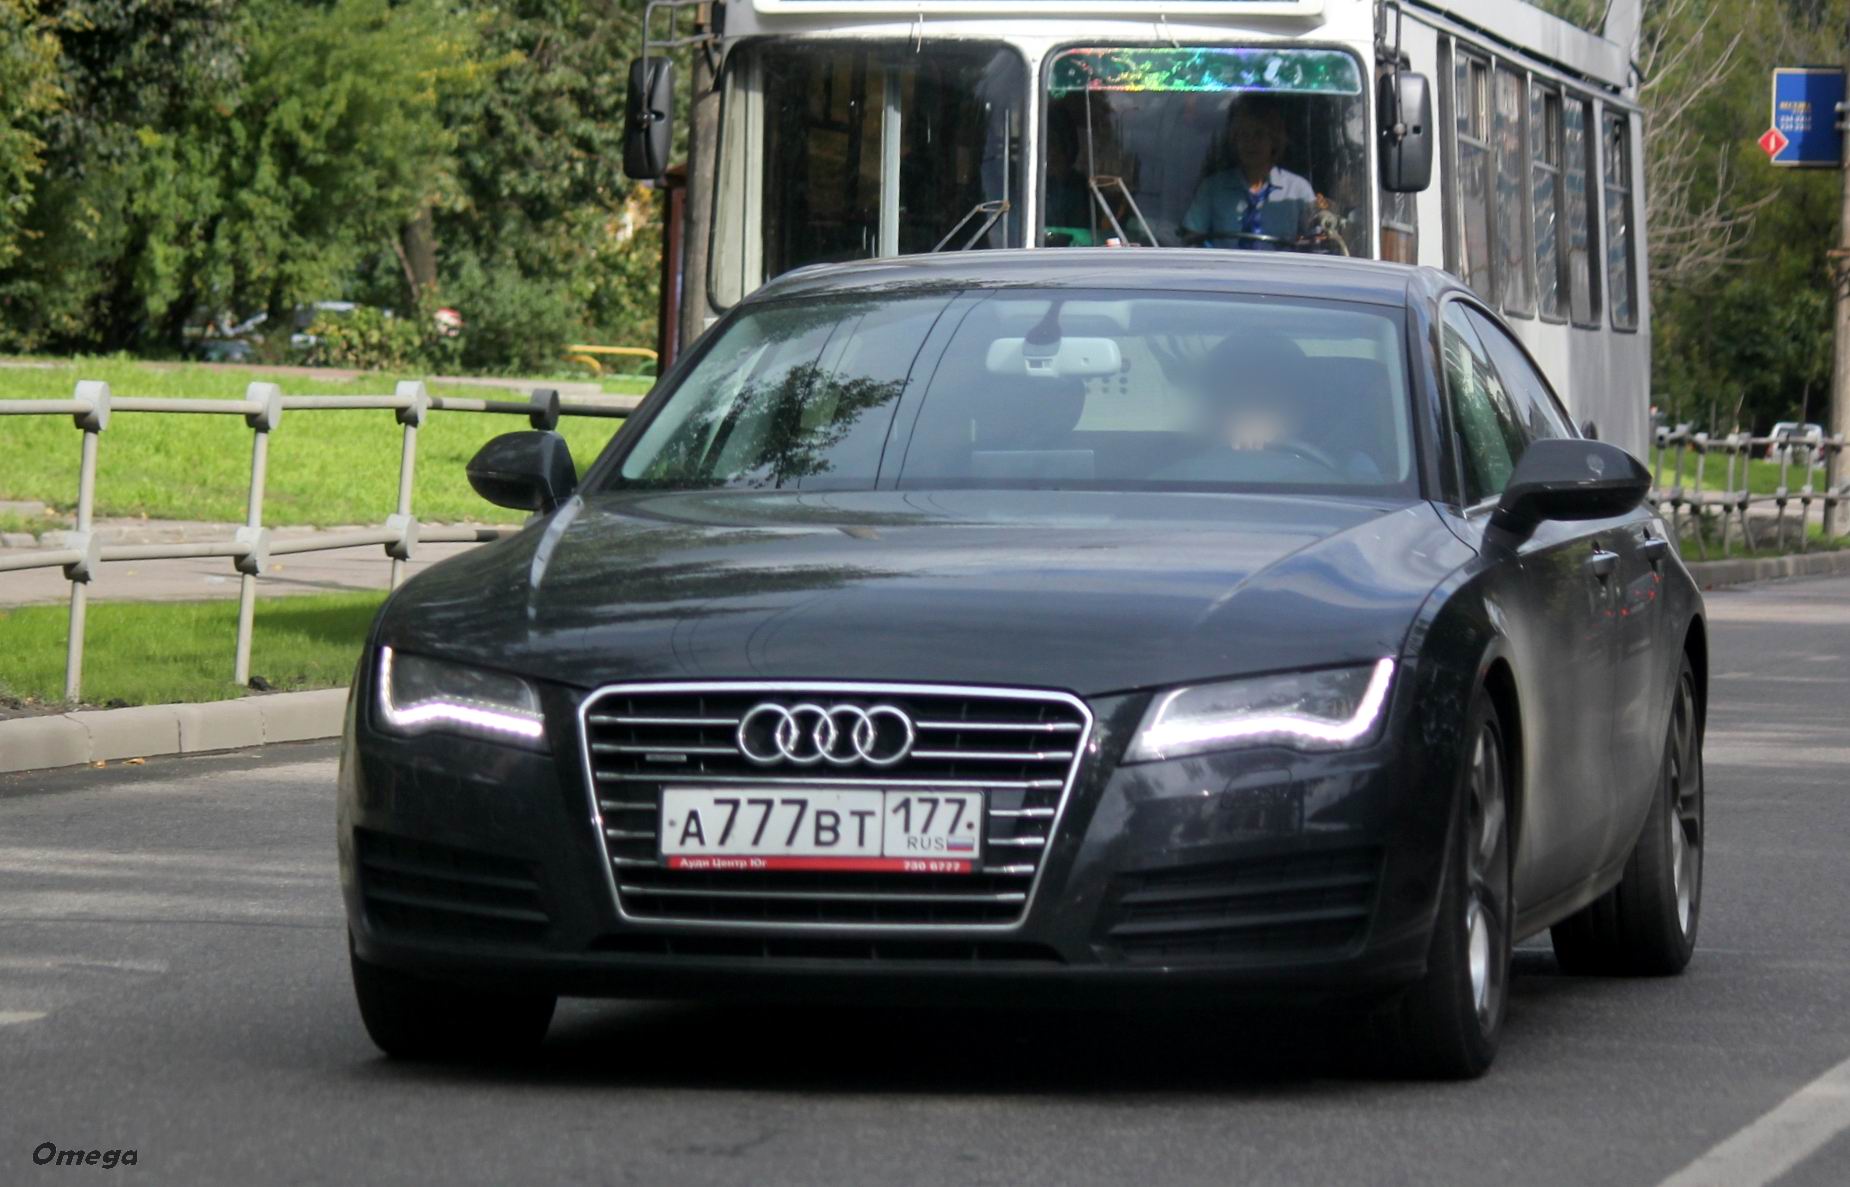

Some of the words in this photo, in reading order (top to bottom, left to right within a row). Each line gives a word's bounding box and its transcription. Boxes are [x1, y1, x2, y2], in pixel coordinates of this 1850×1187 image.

[679, 798, 875, 847] А777ВТ
[892, 797, 967, 834] 177
[906, 836, 945, 850] RUS
[680, 857, 710, 870] Ауди
[712, 857, 747, 870] Центр
